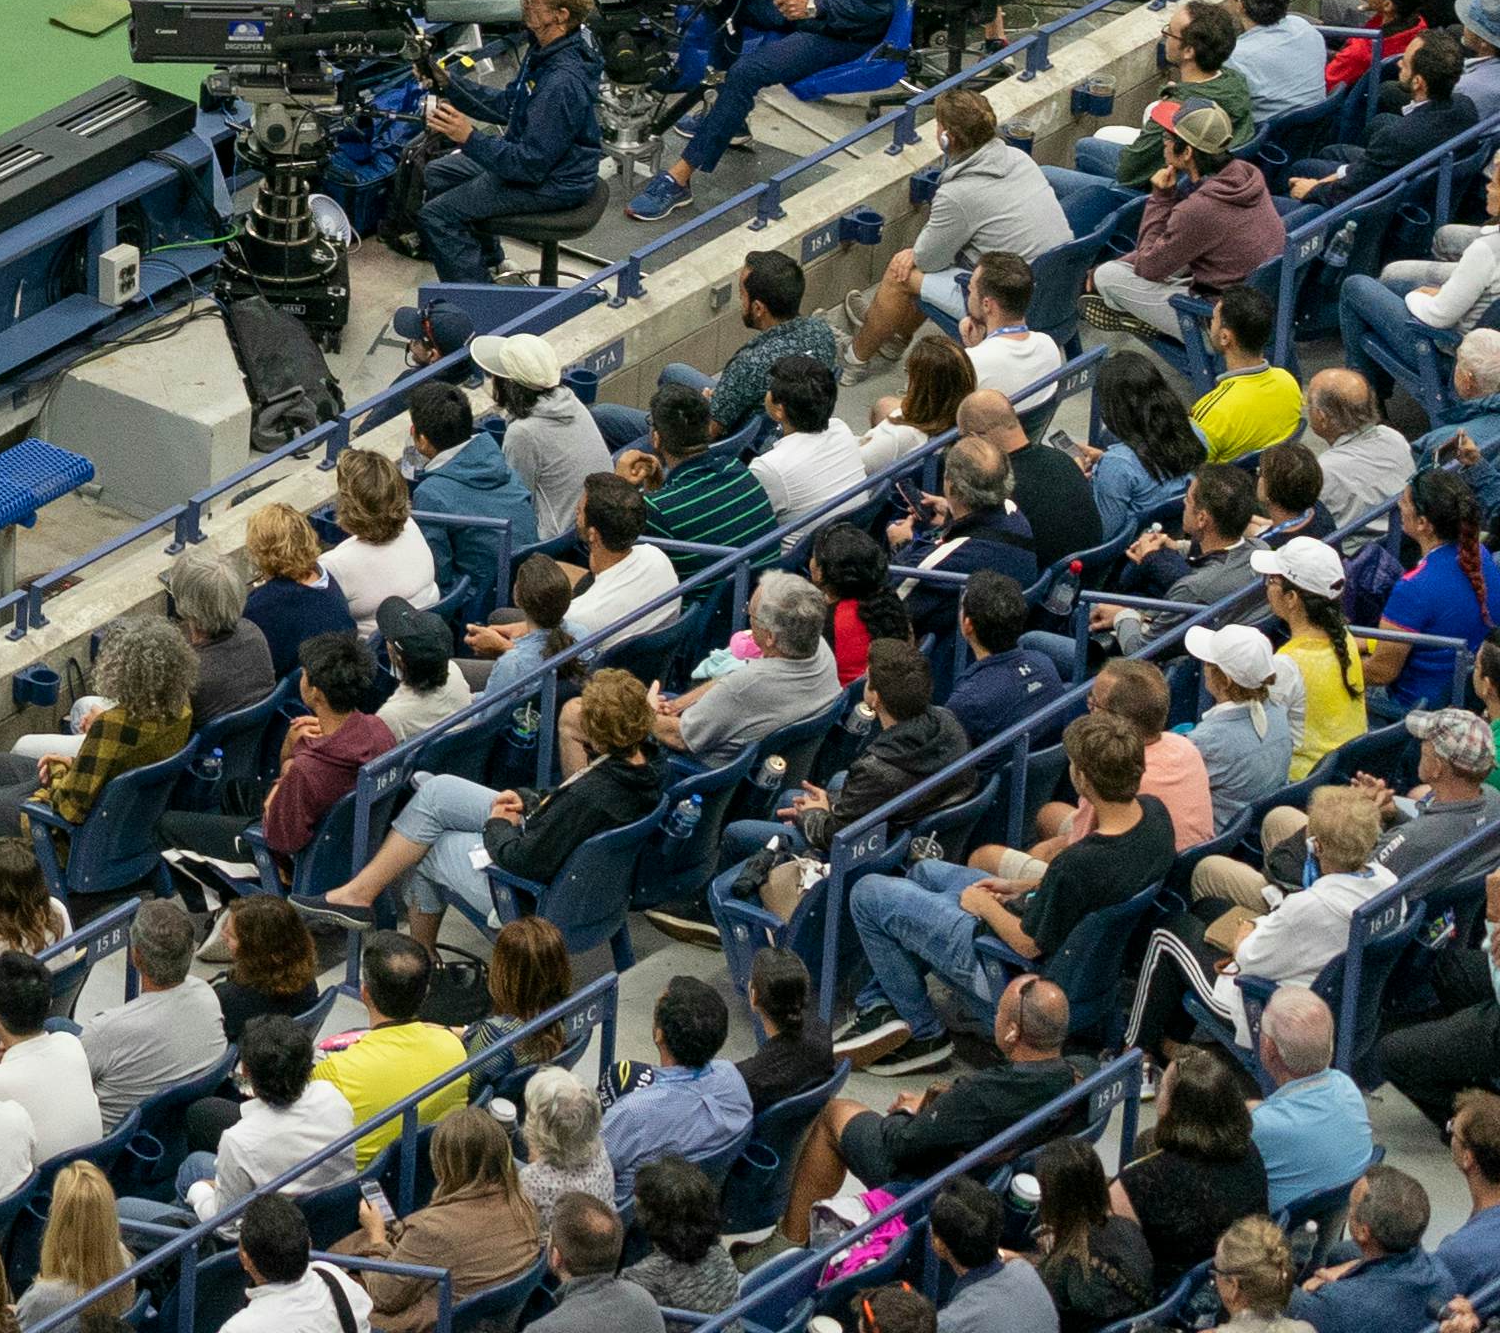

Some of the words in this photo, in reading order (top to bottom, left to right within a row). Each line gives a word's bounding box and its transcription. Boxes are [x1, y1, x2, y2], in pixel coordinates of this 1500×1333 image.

[811, 238, 822, 252] 18
[822, 231, 832, 244] A
[595, 355, 605, 371] 17
[605, 350, 616, 365] A
[1066, 376, 1077, 391] 17
[1080, 369, 1089, 384] B
[852, 843, 865, 860] 16
[868, 834, 879, 851] C
[1371, 917, 1382, 934] 16
[1384, 907, 1395, 924] D
[97, 935, 109, 953] 15
[112, 929, 121, 942] B
[572, 1013, 584, 1030] 15
[587, 1004, 597, 1021] C
[1098, 1091, 1109, 1109] 15
[1112, 1080, 1123, 1095] D
